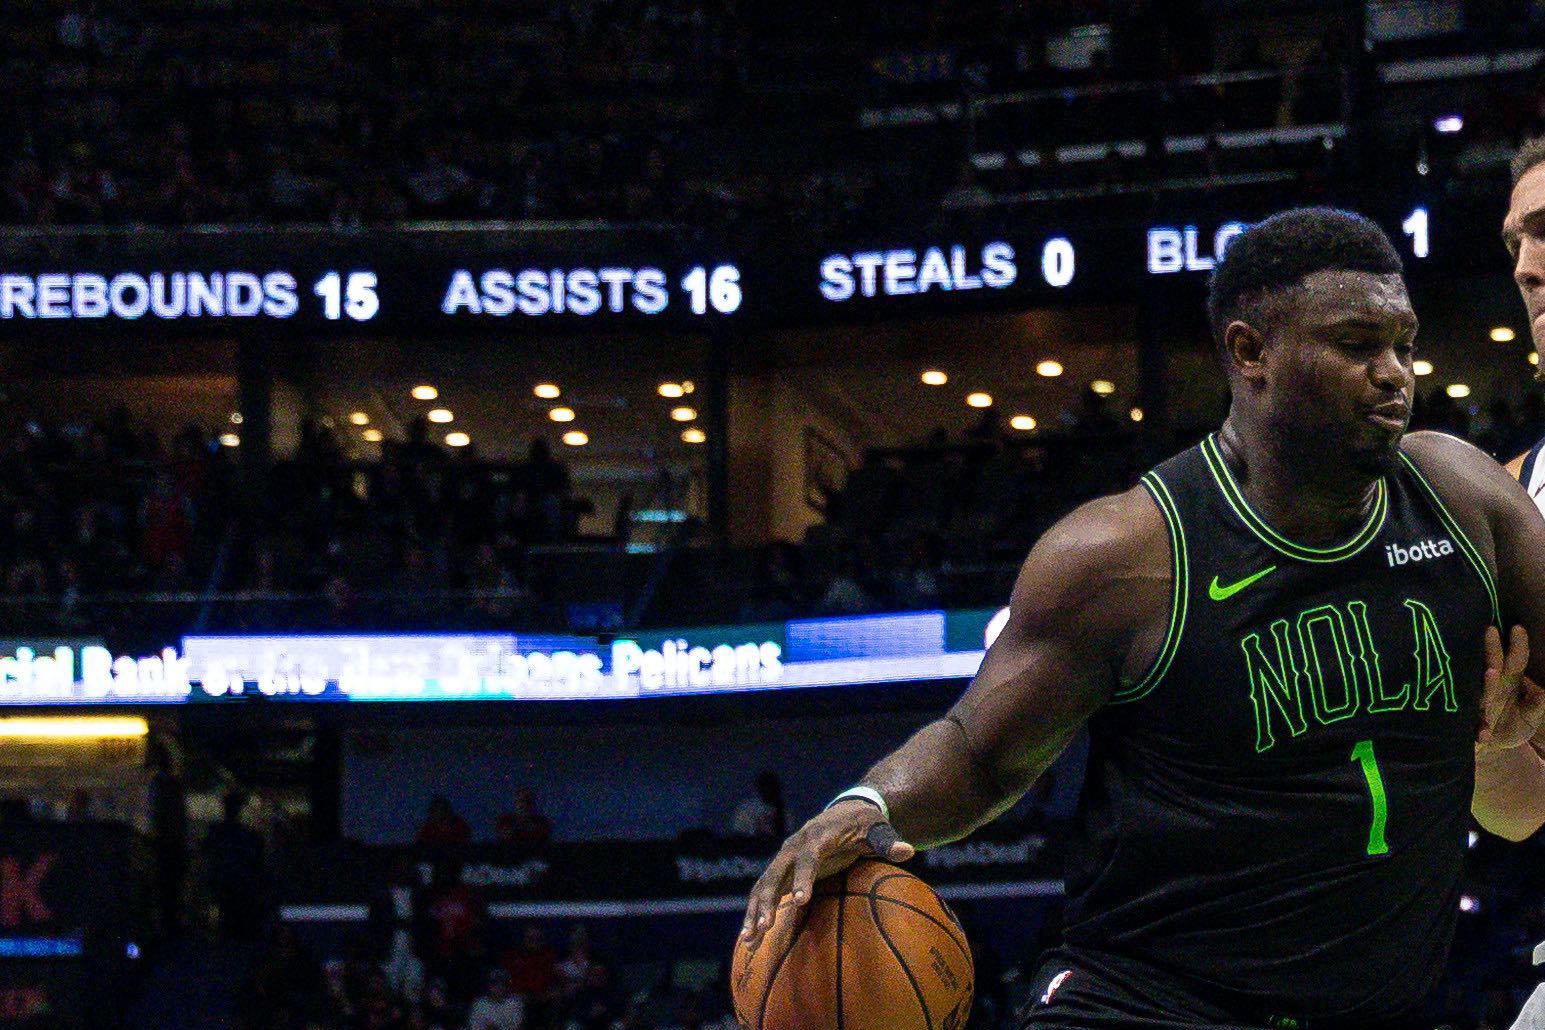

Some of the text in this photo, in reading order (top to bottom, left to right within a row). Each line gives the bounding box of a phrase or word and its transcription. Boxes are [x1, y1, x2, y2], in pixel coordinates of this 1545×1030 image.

[1401, 208, 1429, 258] 1
[0, 271, 380, 322] REBOUNDS 15
[441, 263, 743, 316] ASSISTS 16
[818, 236, 1076, 301] STEALS 0
[1385, 537, 1455, 568] ibotta
[80, 646, 192, 697] Bank
[612, 638, 783, 692] Pelicans
[1241, 599, 1459, 754] NOLA
[1350, 740, 1389, 855] 1
